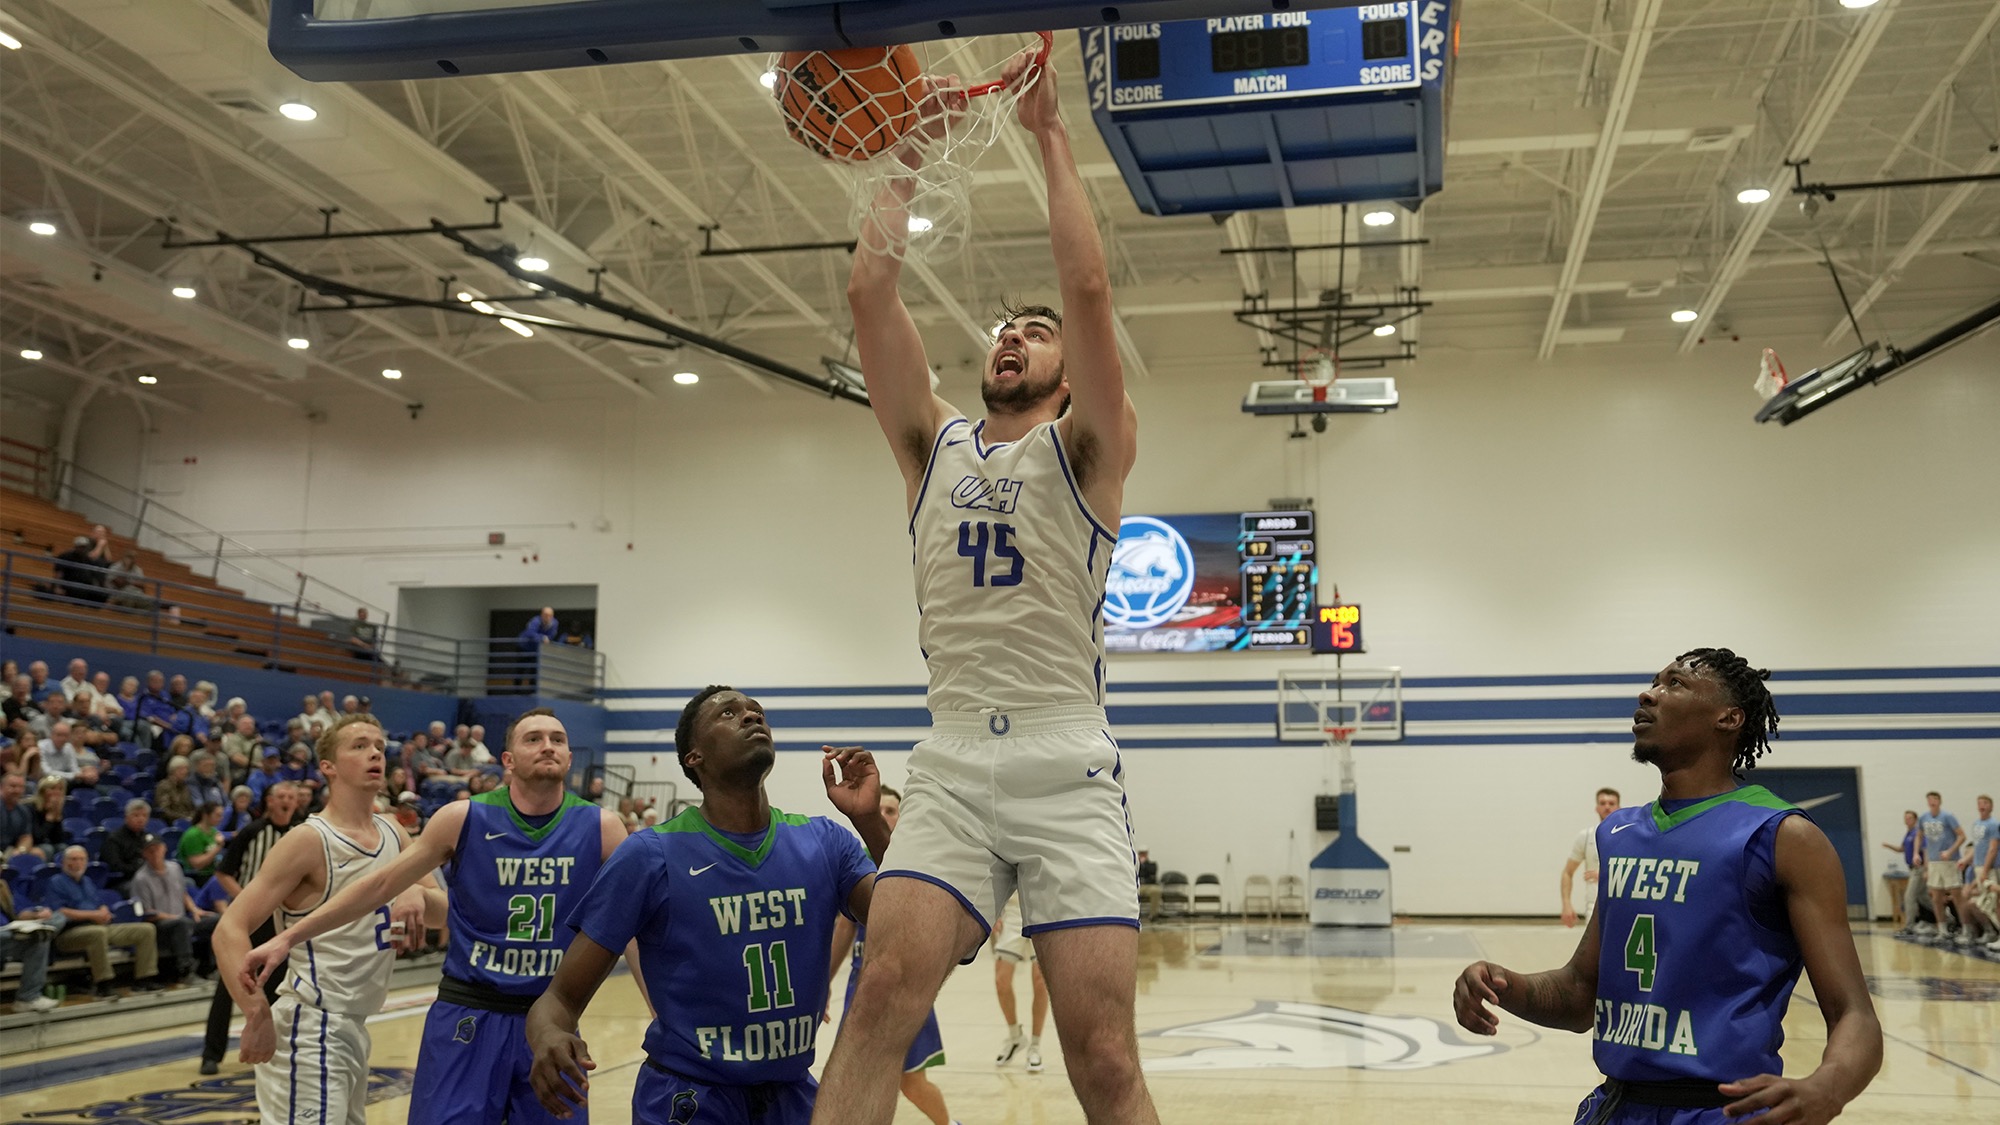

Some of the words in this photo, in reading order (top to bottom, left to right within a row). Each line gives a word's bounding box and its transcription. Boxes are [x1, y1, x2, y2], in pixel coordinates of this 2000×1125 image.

[1207, 14, 1264, 33] PLAYER
[1272, 11, 1311, 27] FOUL
[1358, 2, 1409, 21] FOULS
[1114, 23, 1161, 41] FOULS
[1234, 74, 1287, 94] MATCH
[1360, 64, 1412, 85] SCORE
[1114, 84, 1163, 104] SCORE
[951, 475, 1023, 514] UAH
[1257, 517, 1297, 530] ARGOS
[957, 521, 1025, 587] 45
[1250, 542, 1267, 556] 17
[1320, 606, 1359, 624] 14:00
[1252, 632, 1294, 644] PERIOD
[1296, 630, 1306, 645] 1
[1331, 622, 1354, 648] 15
[496, 857, 574, 886] WEST
[1607, 857, 1700, 903] WEST
[506, 893, 556, 942] 21
[709, 888, 806, 935] WEST
[469, 941, 564, 977] FLORID
[1624, 913, 1657, 992] 4
[742, 940, 795, 1013] 11
[696, 1012, 819, 1062] FLORID
[1593, 998, 1698, 1056] FLORIDA
